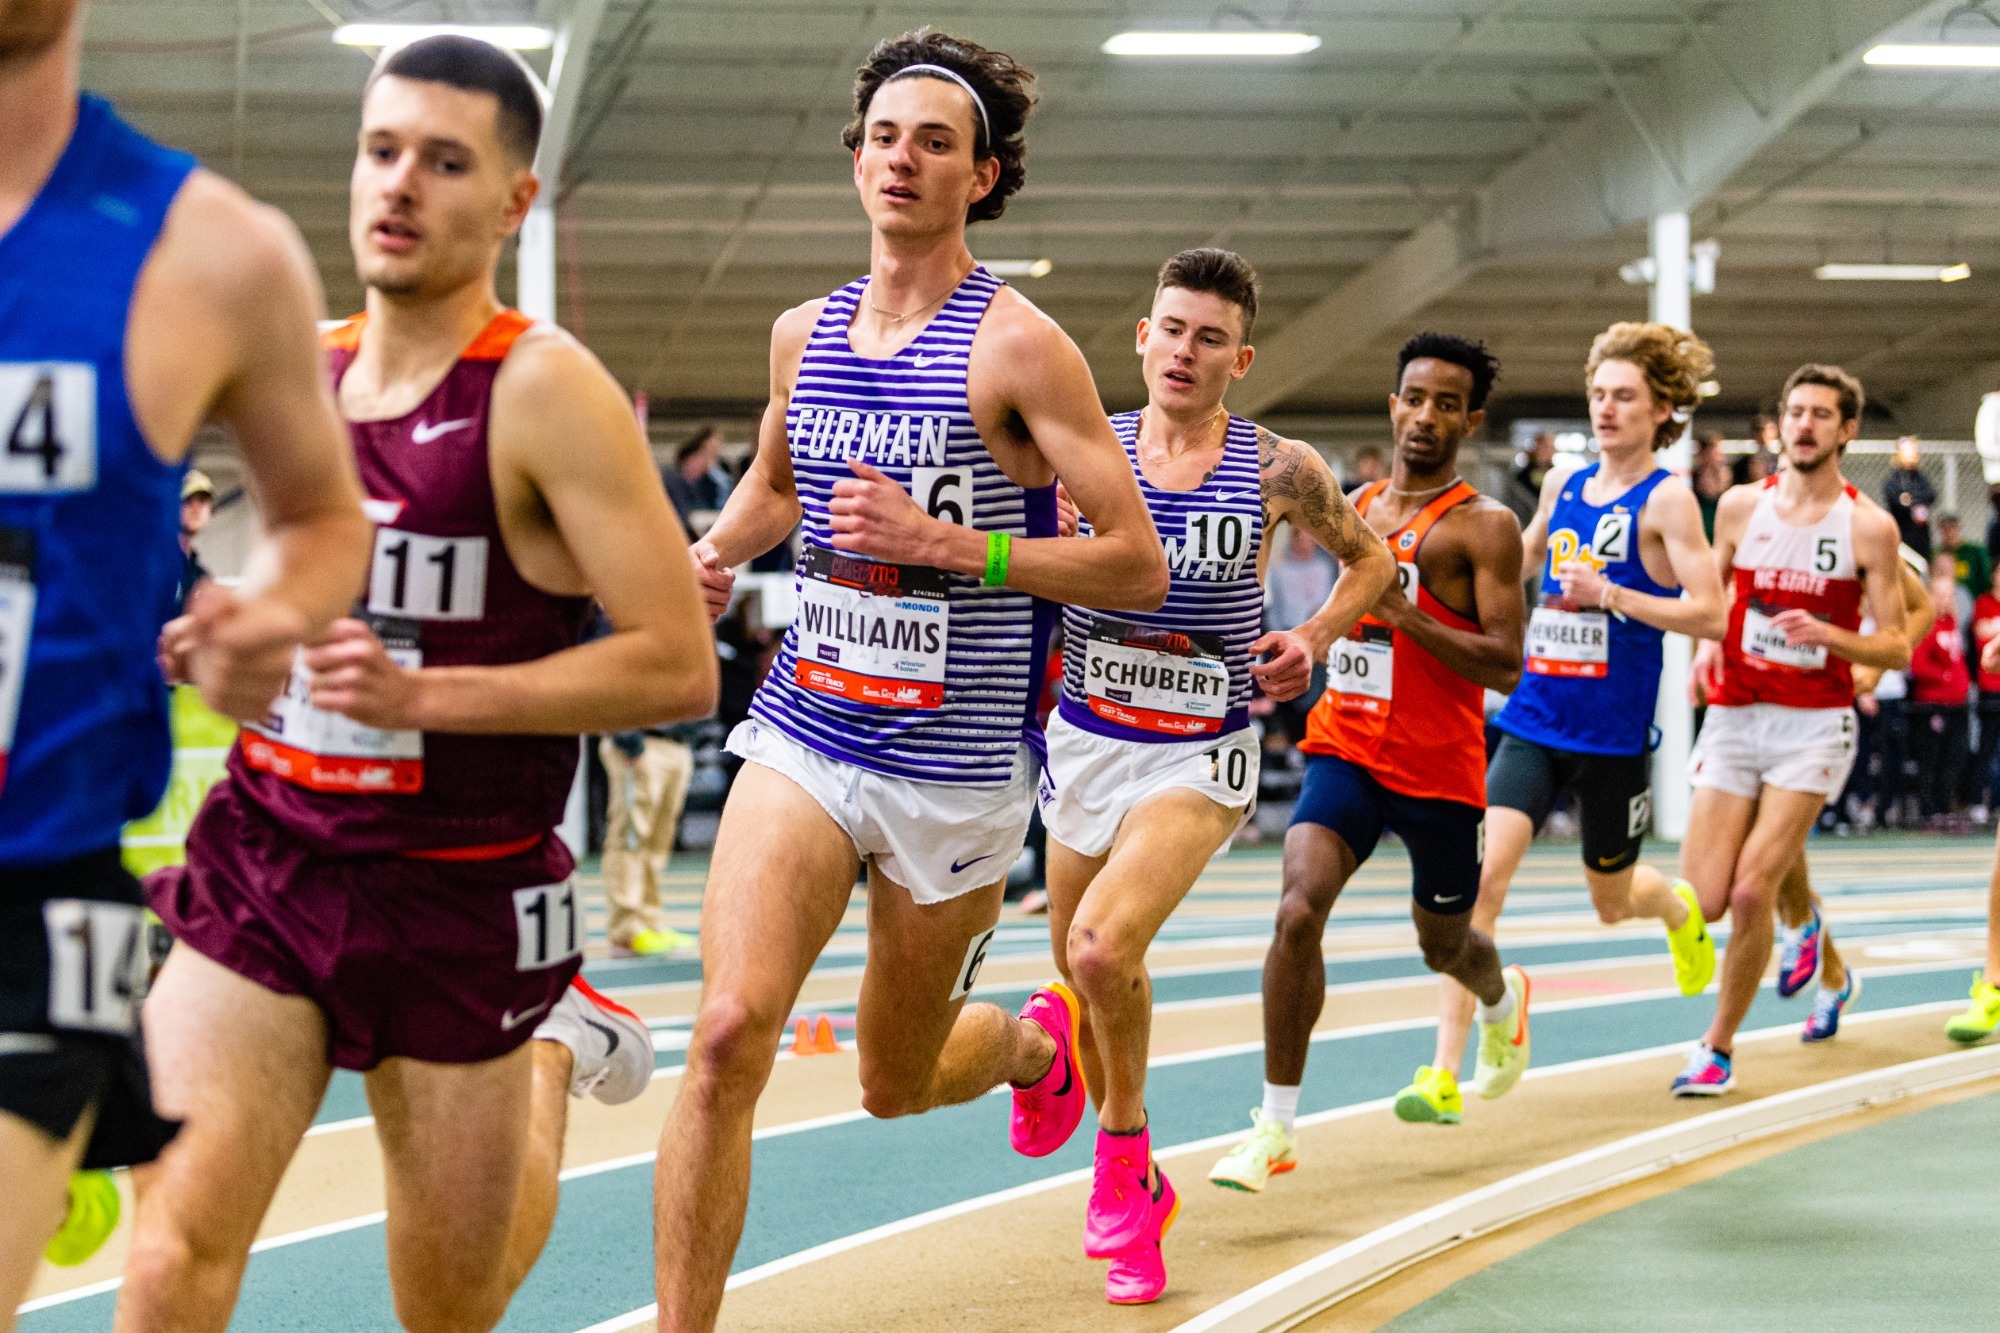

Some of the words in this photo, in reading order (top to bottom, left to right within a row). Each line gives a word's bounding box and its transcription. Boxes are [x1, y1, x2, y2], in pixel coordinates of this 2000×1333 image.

[793, 408, 950, 467] FURMAN
[927, 473, 964, 527] 6
[1191, 514, 1243, 561] 10
[1597, 519, 1622, 558] 2
[1815, 538, 1837, 572] 5
[384, 540, 456, 613] 11
[803, 600, 941, 655] WILLIAMS
[901, 601, 940, 613] MONDO
[810, 674, 826, 683] FAST
[825, 677, 845, 689] TRACK
[1090, 656, 1225, 696] SCHUBERT
[1099, 706, 1116, 715] FAST
[1117, 711, 1137, 721] TRACK
[1203, 748, 1246, 791] 10
[525, 891, 574, 962] 11
[963, 929, 995, 992] 6
